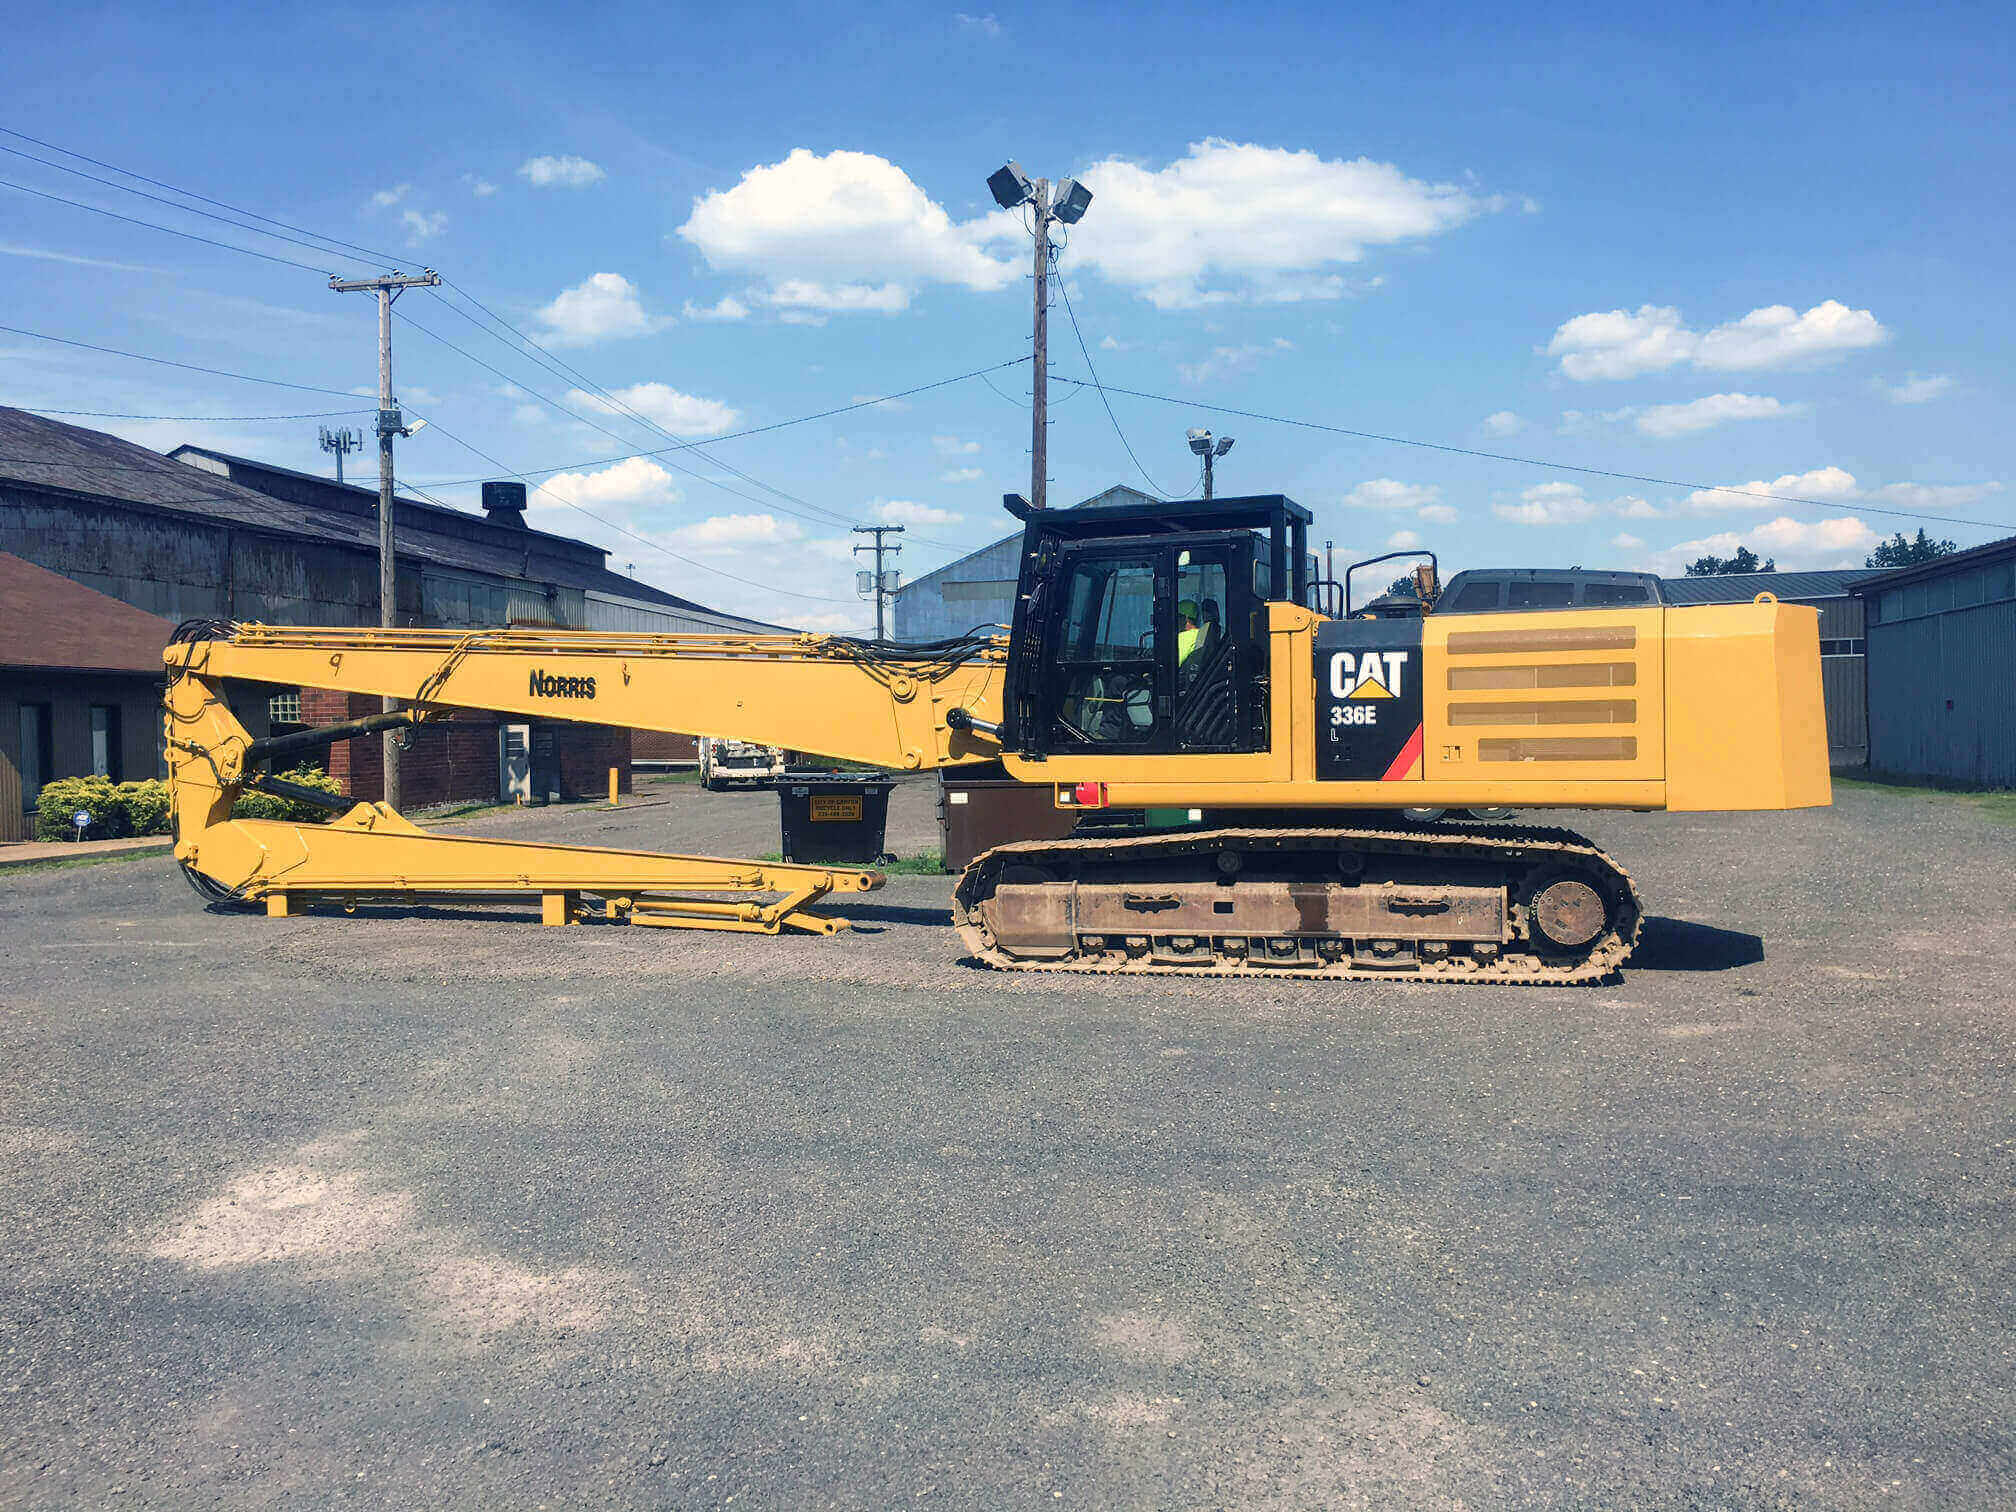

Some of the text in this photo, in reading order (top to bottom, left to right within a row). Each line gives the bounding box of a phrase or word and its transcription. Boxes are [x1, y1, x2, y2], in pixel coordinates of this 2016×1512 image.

[529, 669, 596, 699] NORRIS
[1330, 652, 1408, 699] CAT
[1330, 705, 1377, 725] 336E
